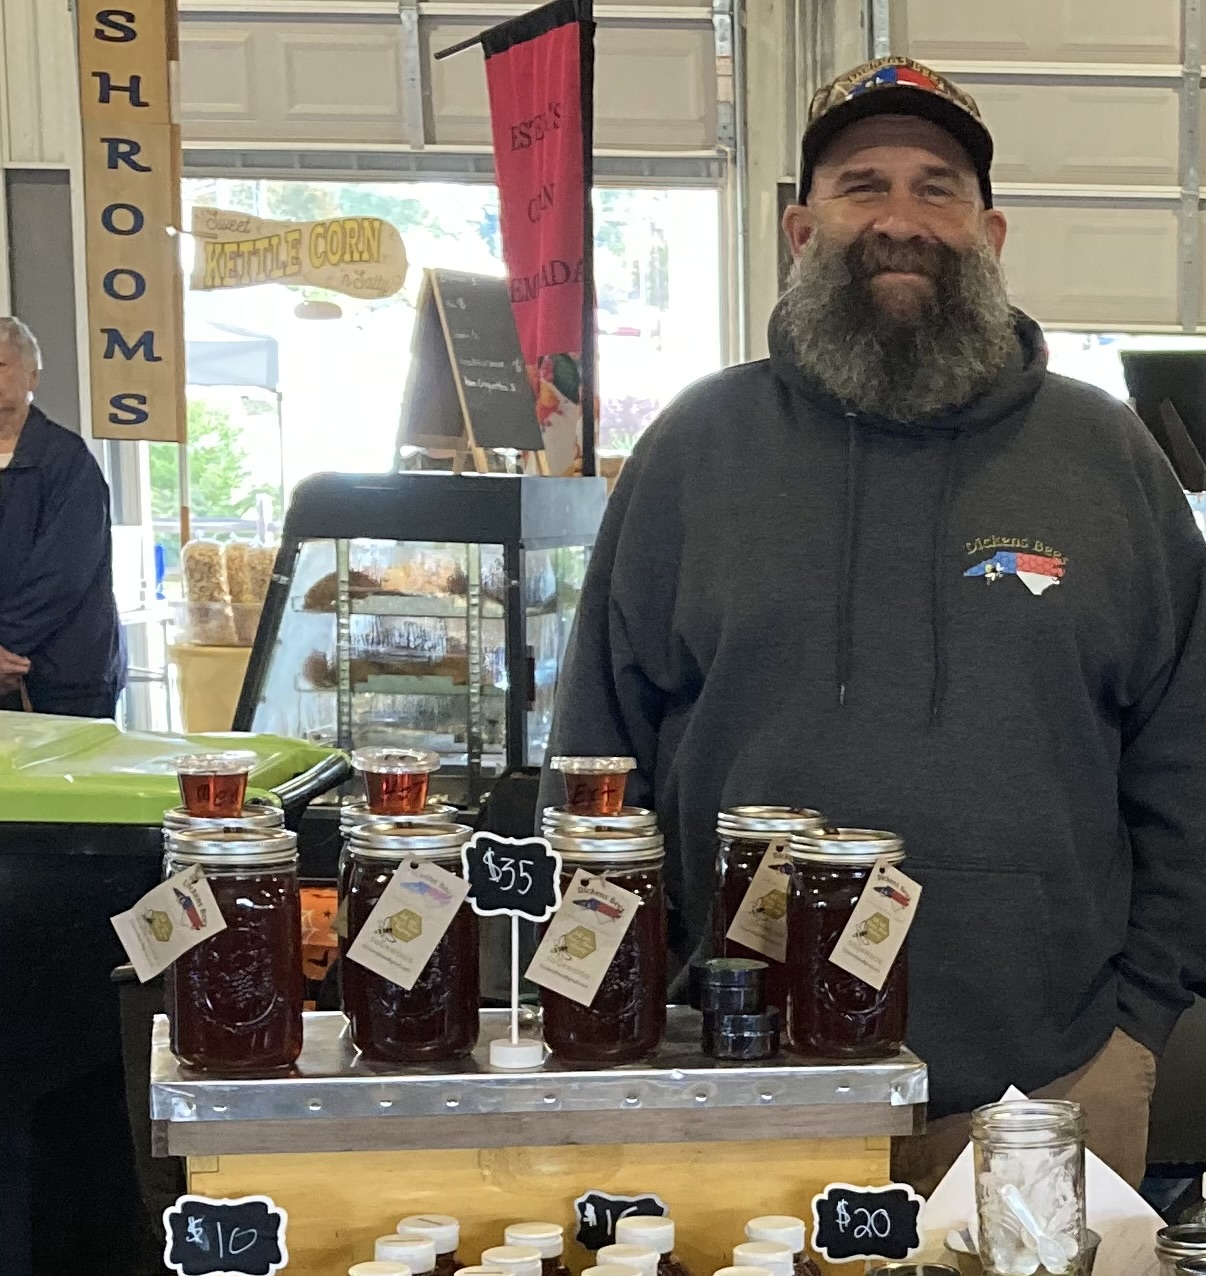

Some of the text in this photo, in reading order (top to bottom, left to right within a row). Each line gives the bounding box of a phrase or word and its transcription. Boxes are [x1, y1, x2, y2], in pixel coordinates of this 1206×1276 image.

[91, 10, 162, 426] SHROOMS
[203, 217, 382, 289] KETTLE CORN
[482, 846, 535, 895] $35
[186, 1214, 258, 1259] $10
[583, 1202, 638, 1236] $1
[836, 1198, 891, 1239] $20
